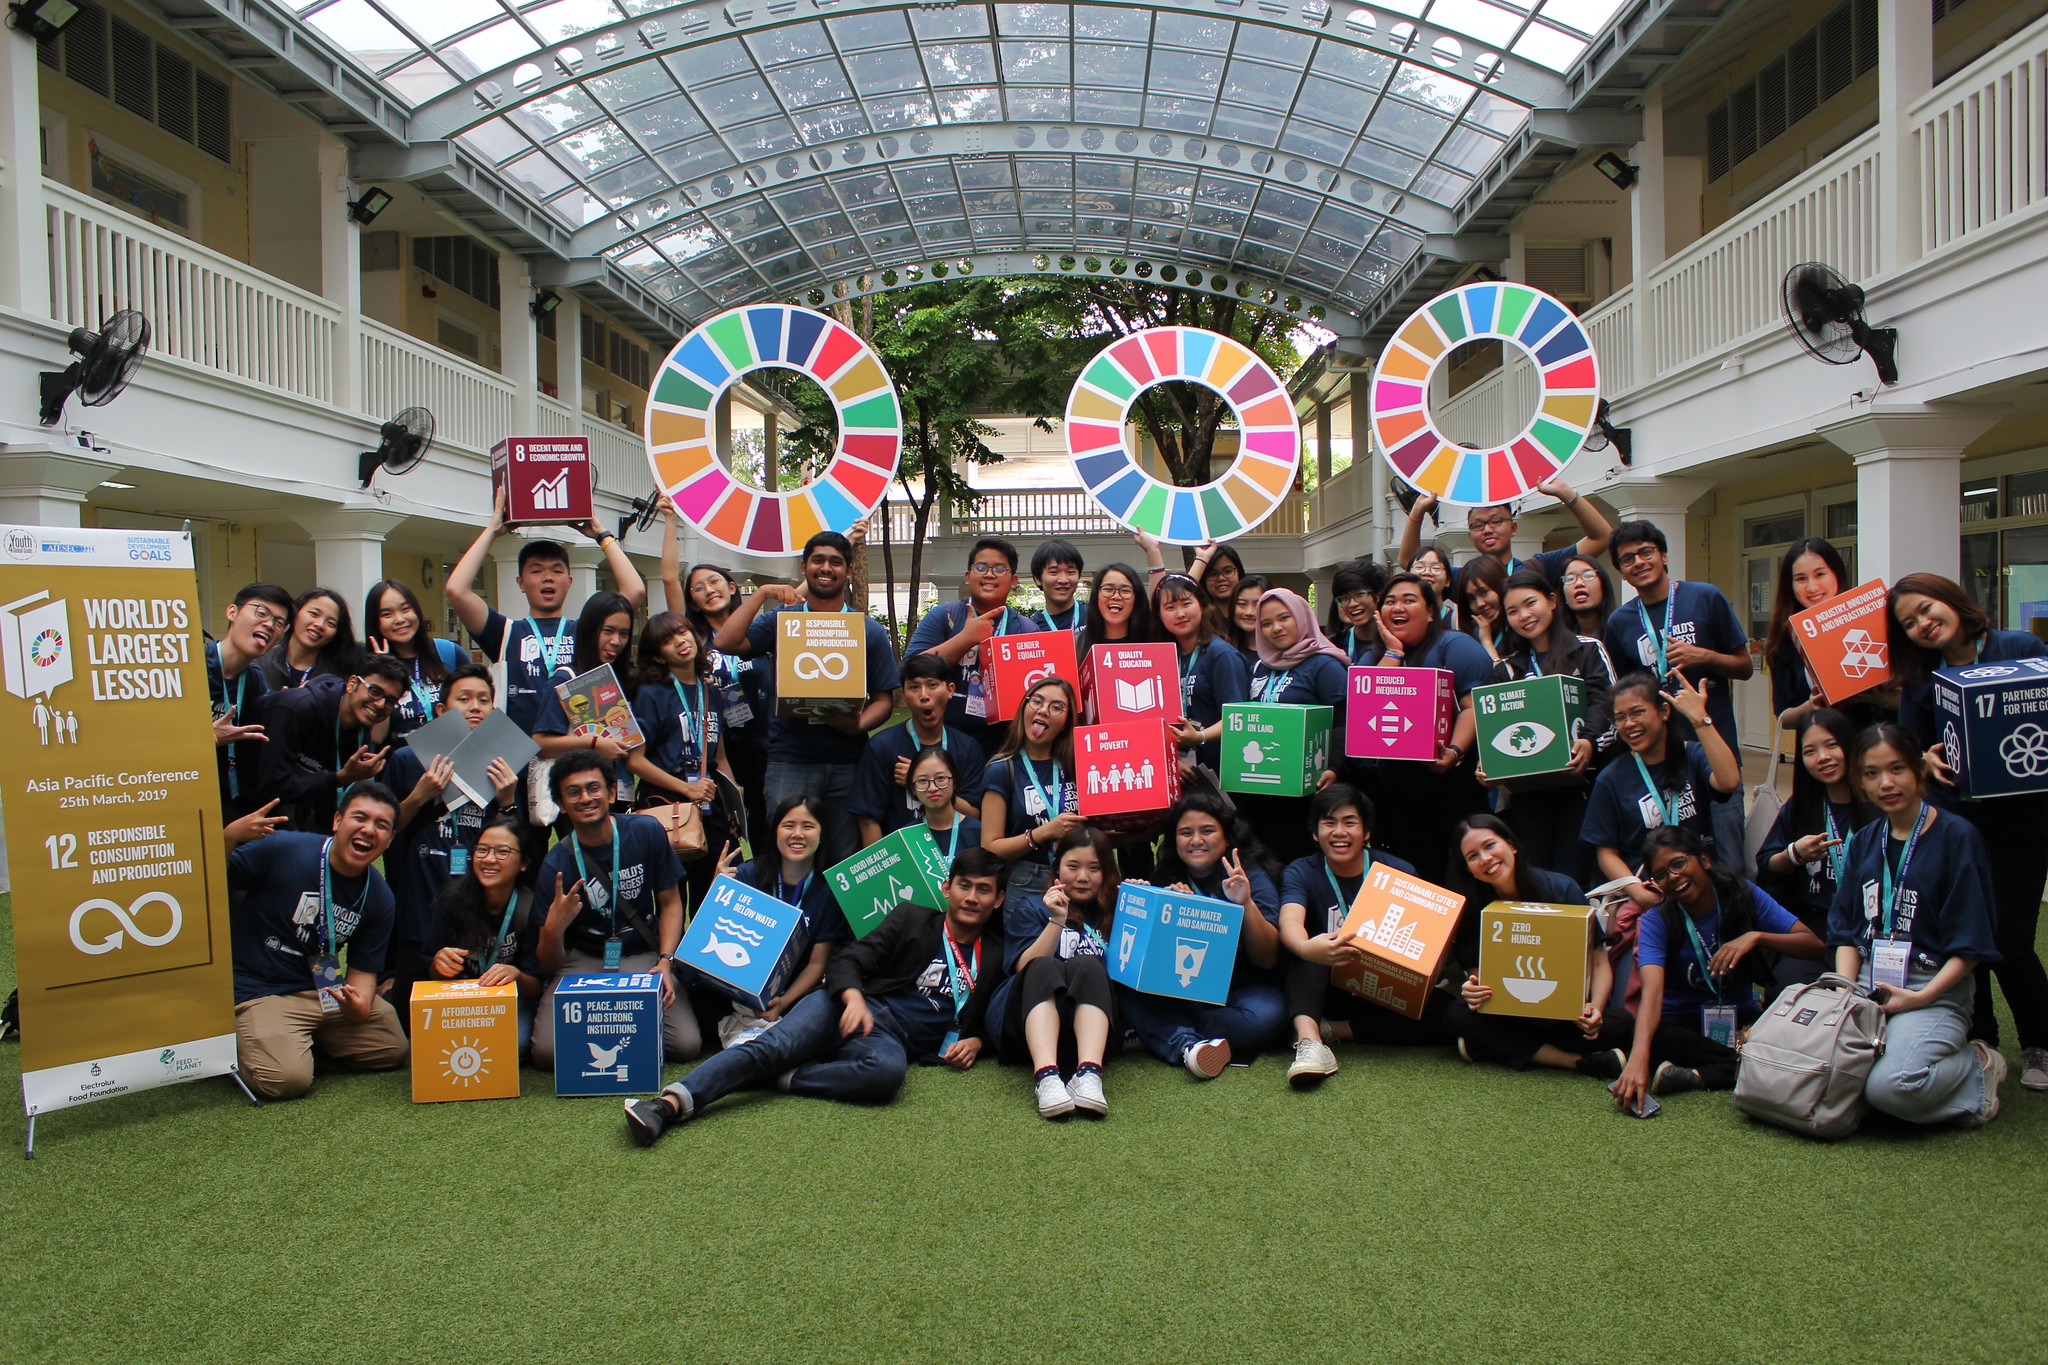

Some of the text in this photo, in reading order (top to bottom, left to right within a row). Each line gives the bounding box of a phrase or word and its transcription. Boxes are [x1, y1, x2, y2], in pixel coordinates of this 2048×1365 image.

[516, 444, 526, 462] 8
[529, 444, 582, 452] DECENT WORK AND
[530, 454, 586, 462] ECONOMIC GROWTH
[10, 534, 32, 548] Youth
[129, 550, 172, 561] GOALS
[1846, 586, 1885, 609] INNOVATION
[84, 598, 188, 629] WORLD'S
[785, 620, 800, 637] 12
[806, 620, 846, 628] RESPONSIBLE
[1802, 618, 1818, 638] 9
[1821, 621, 1836, 633] AND
[806, 630, 849, 638] CONSUMPTION
[88, 633, 190, 664] LARGEST
[806, 639, 858, 648] AND PRODUCTION
[1016, 640, 1040, 650] GENDER
[1001, 643, 1011, 661] 5
[1018, 649, 1046, 660] EQUALITY
[1103, 652, 1113, 668] 4
[1118, 650, 1142, 660] QUALITY
[1118, 660, 1152, 668] EDUCATION
[91, 668, 182, 700] LESSON
[1354, 675, 1371, 694] 10
[1376, 676, 1405, 686] REDUCED
[1376, 686, 1417, 696] INEQUALITIES
[1500, 688, 1526, 702] CLIMATE
[1479, 694, 1496, 714] 13
[1501, 700, 1524, 712] ACTION
[1975, 694, 1995, 718] 17
[2004, 704, 2020, 716] FOR
[2022, 701, 2038, 714] THE
[1228, 712, 1244, 732] 15
[1248, 714, 1260, 722] LIFE
[1098, 732, 1108, 740] NO
[1248, 724, 1274, 733] ON LAND
[1084, 733, 1092, 752] 1
[1100, 740, 1128, 750] POVERTY
[26, 770, 200, 792] Asia Pacific Conference
[59, 789, 168, 808] 25th March, 2019
[88, 824, 166, 846] RESPONSIBLE
[45, 834, 78, 870] 12
[90, 842, 175, 865] CONSUMPTION
[849, 848, 888, 875] GOOD HEALTH
[856, 852, 901, 885] AND WELL-BEING
[92, 860, 192, 884] AND PRODUCTION
[836, 872, 850, 892] 3
[1373, 872, 1390, 890] 11
[714, 884, 736, 908] 14
[738, 893, 752, 906] LIFE
[1389, 886, 1448, 916] AND COMMUNITIES
[1394, 877, 1458, 909] SUSTAINABLE CITIES
[1120, 892, 1126, 912] 6
[733, 902, 778, 929] BELOW WATER
[1161, 904, 1172, 924] 6
[1179, 906, 1222, 922] CLEAN WATER
[1176, 918, 1228, 934] AND SANITATION
[1492, 920, 1503, 942] 2
[1512, 922, 1530, 932] ZERO
[1511, 934, 1541, 945] HUNGER
[606, 950, 620, 958] 102
[442, 1004, 506, 1018] AFFORDABLE AND
[562, 1002, 582, 1024] 16
[586, 1000, 644, 1012] PEACE, JUSTICE
[422, 1008, 432, 1030] 7
[442, 1017, 496, 1030] CLEAN ENERGY
[586, 1012, 634, 1023] AND STRONG
[586, 1024, 637, 1035] INSTITUTIONS
[176, 1058, 192, 1066] FEED
[176, 1061, 202, 1072] PLANET
[80, 1079, 116, 1091] Electrolux
[68, 1085, 128, 1102] Food Foundation
